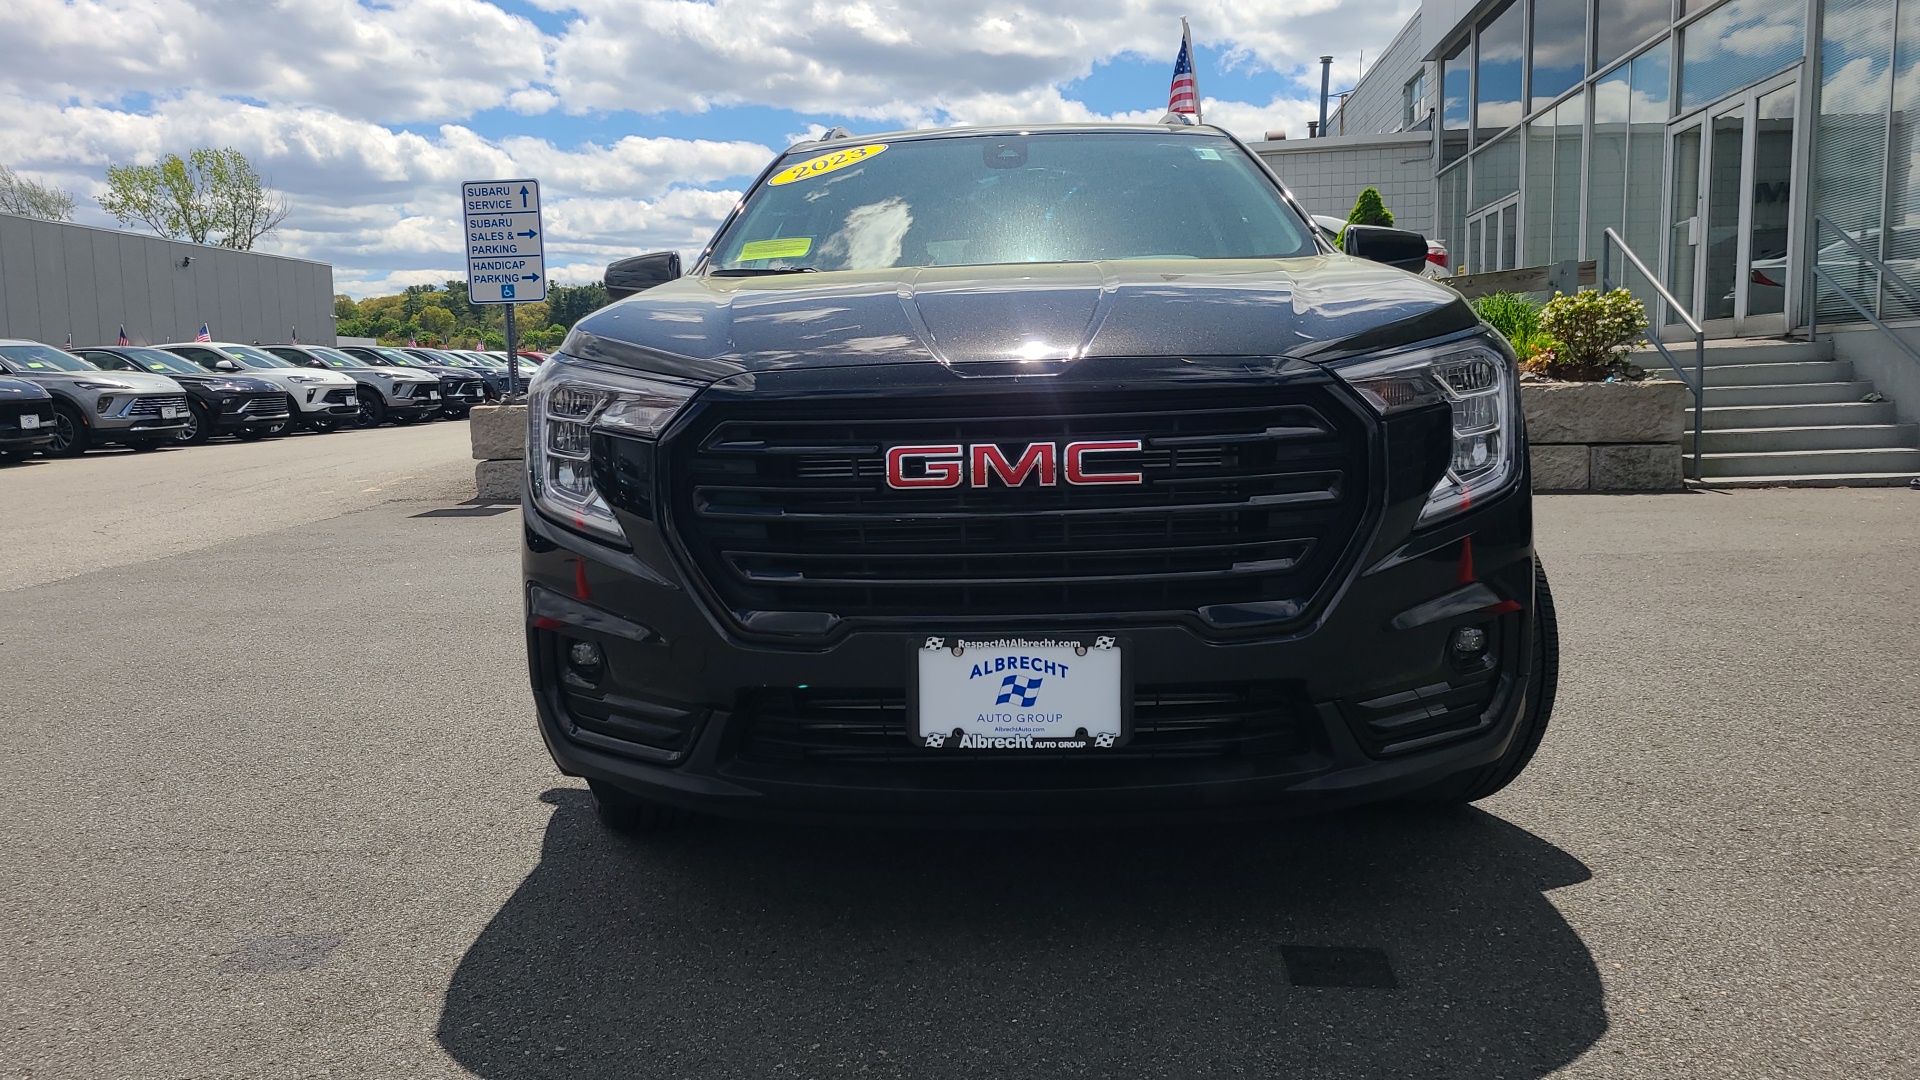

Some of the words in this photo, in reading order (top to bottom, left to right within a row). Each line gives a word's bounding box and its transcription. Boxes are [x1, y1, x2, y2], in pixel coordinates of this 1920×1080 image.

[792, 148, 867, 179] 2023
[467, 187, 510, 197] SUBARU
[468, 200, 512, 210] SERVICE
[470, 218, 512, 228] SUBARU
[471, 232, 504, 241] SALES
[507, 231, 514, 240] &
[472, 244, 517, 254] PARKING
[473, 261, 525, 270] HANDICAP
[474, 274, 519, 283] PARKING
[886, 440, 1143, 490] GMC
[957, 638, 1081, 649] RespectAtAlbrecht.com
[969, 656, 1069, 680] ALBRECHT
[977, 713, 1012, 723] AUTO
[1016, 713, 1063, 723] GROUP
[958, 734, 1034, 749] Albrecht
[1035, 741, 1056, 749] AUTO
[1058, 741, 1086, 749] GROUP
